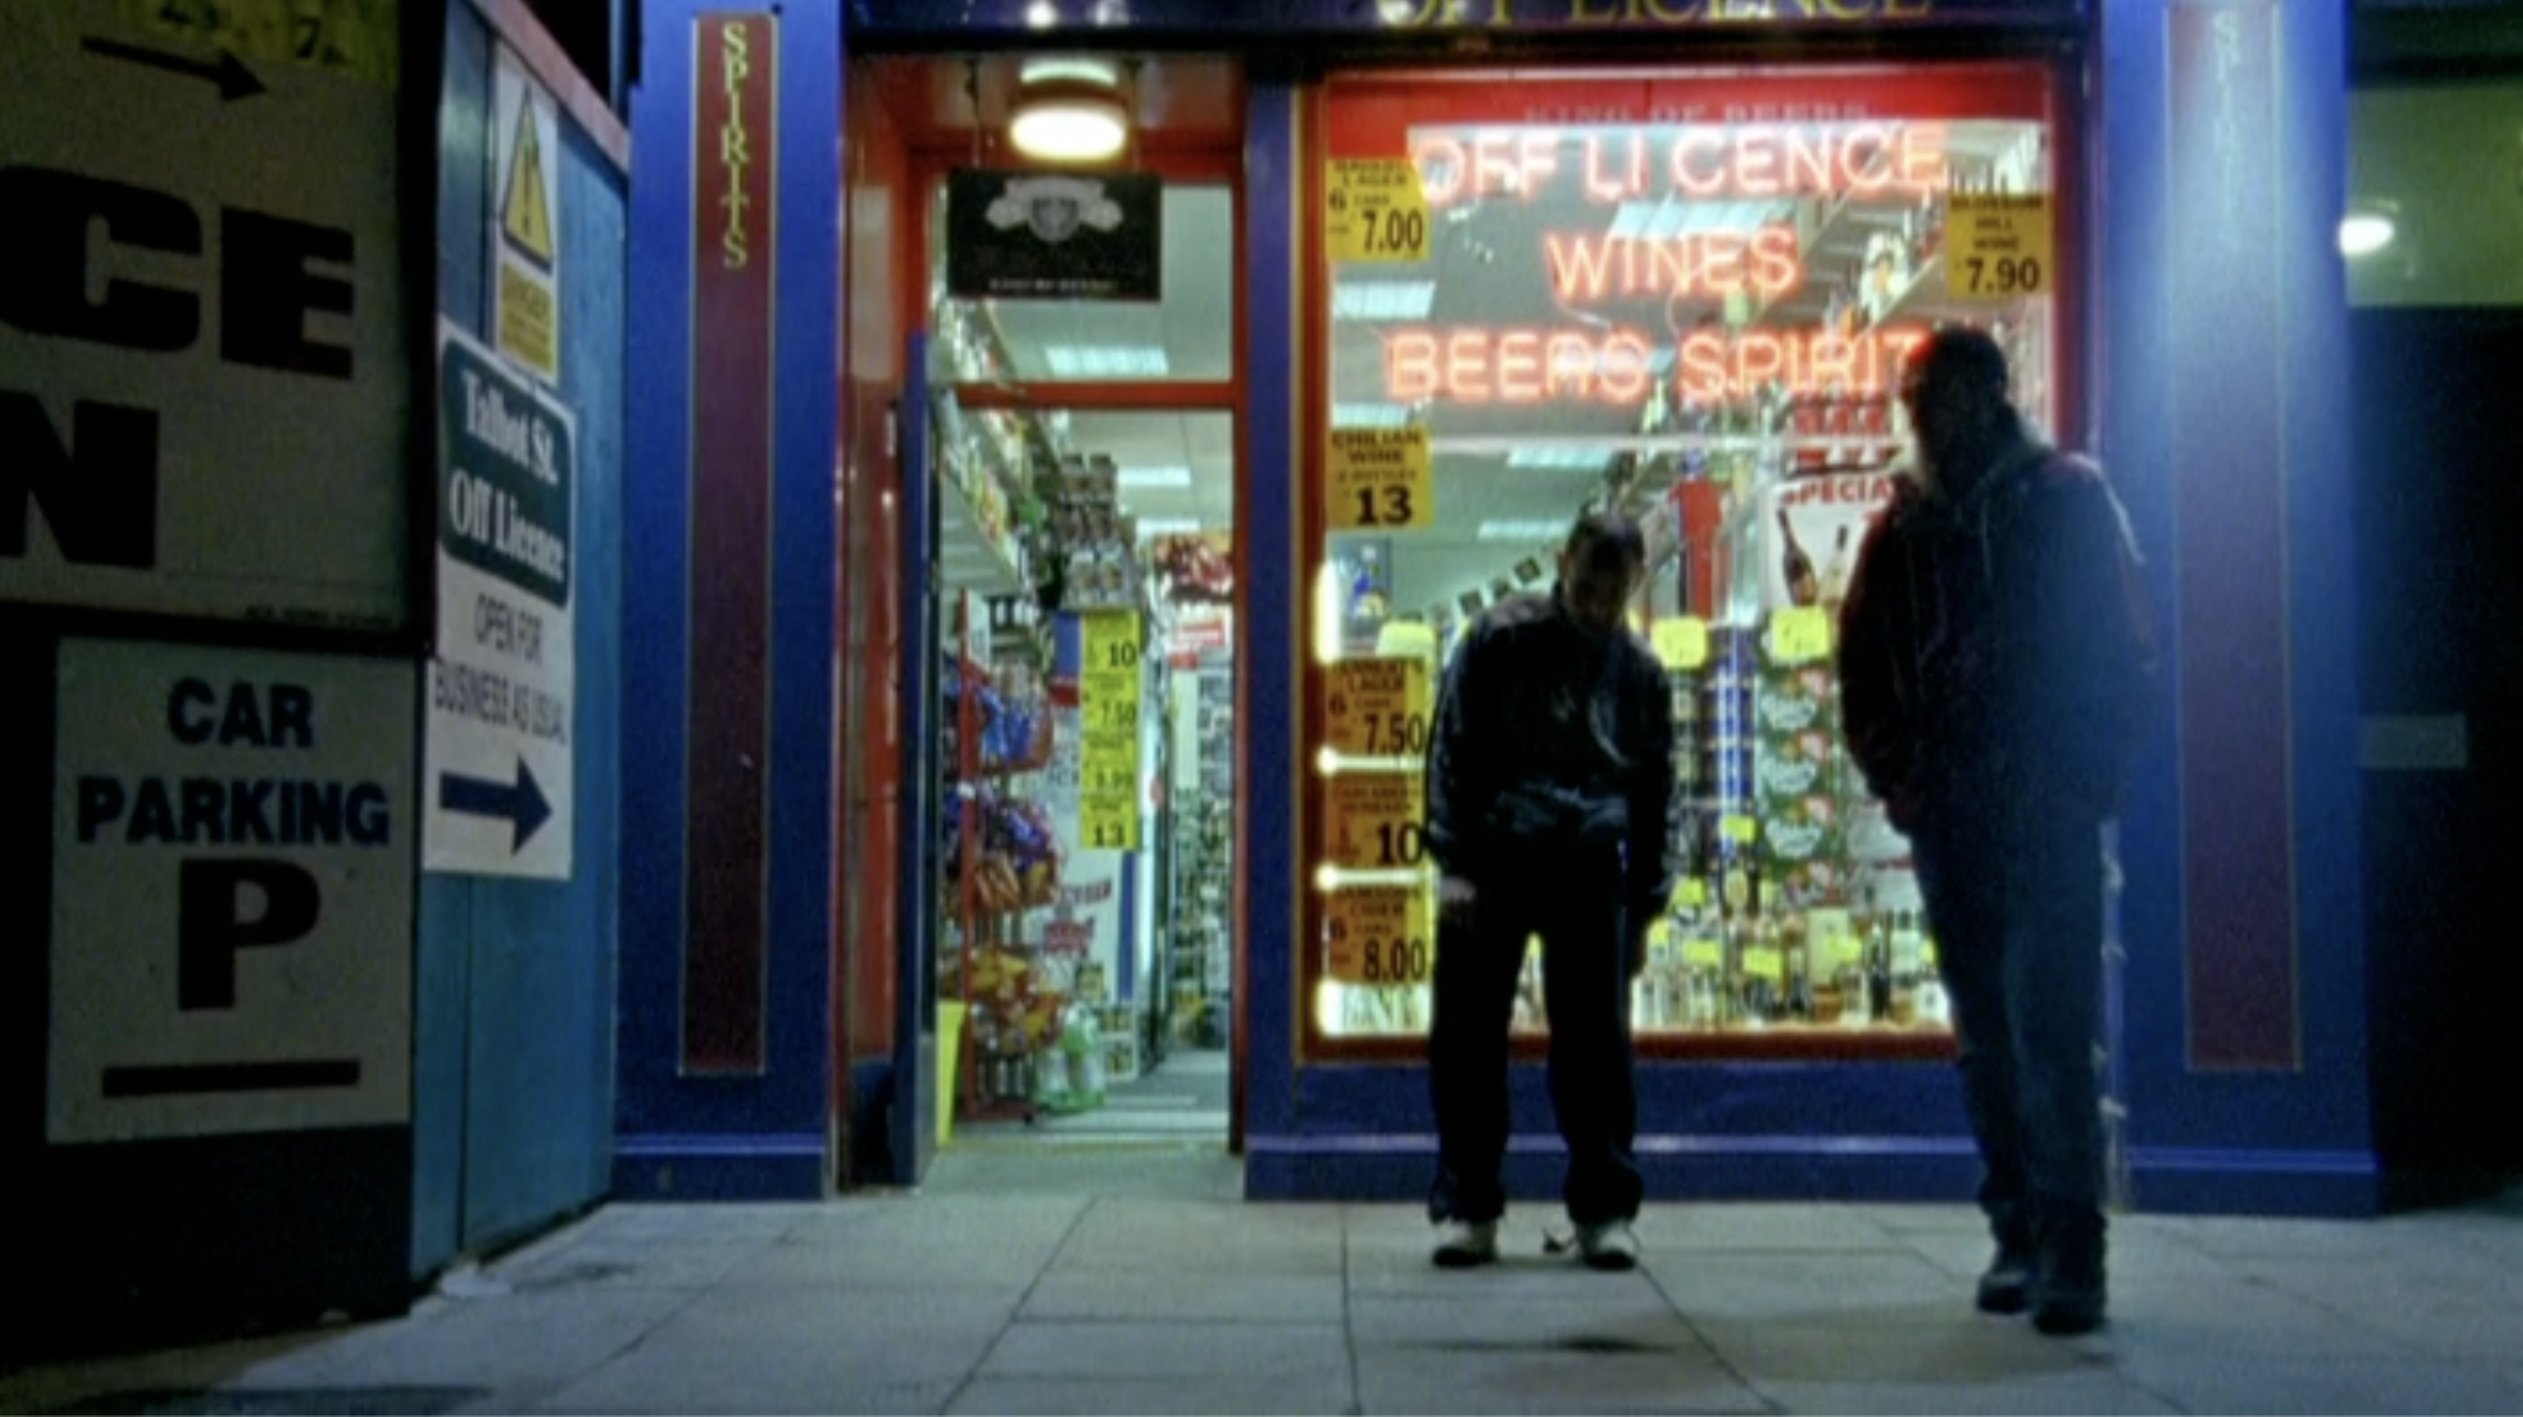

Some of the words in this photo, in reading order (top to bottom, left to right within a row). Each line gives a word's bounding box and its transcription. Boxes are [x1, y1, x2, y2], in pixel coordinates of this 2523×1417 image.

[719, 21, 751, 270] SPIRITS
[1414, 132, 1558, 203] OFF
[1361, 208, 1424, 253] 7.00
[1545, 222, 1801, 300] WINES
[1965, 256, 2040, 294] 7.90
[1383, 329, 1652, 402] BEERS
[1678, 329, 1932, 400] SPIRIT
[461, 369, 530, 469] Talbot
[448, 468, 493, 545] Off
[494, 490, 567, 583] Licence
[1355, 484, 1413, 526] 13
[474, 592, 515, 654] OPEN
[167, 677, 315, 748] CAR
[1364, 712, 1426, 755] 7.50
[75, 776, 390, 846] PARKING
[1376, 820, 1423, 866] 10
[178, 858, 320, 1012] P
[1363, 937, 1426, 981] 8.00
